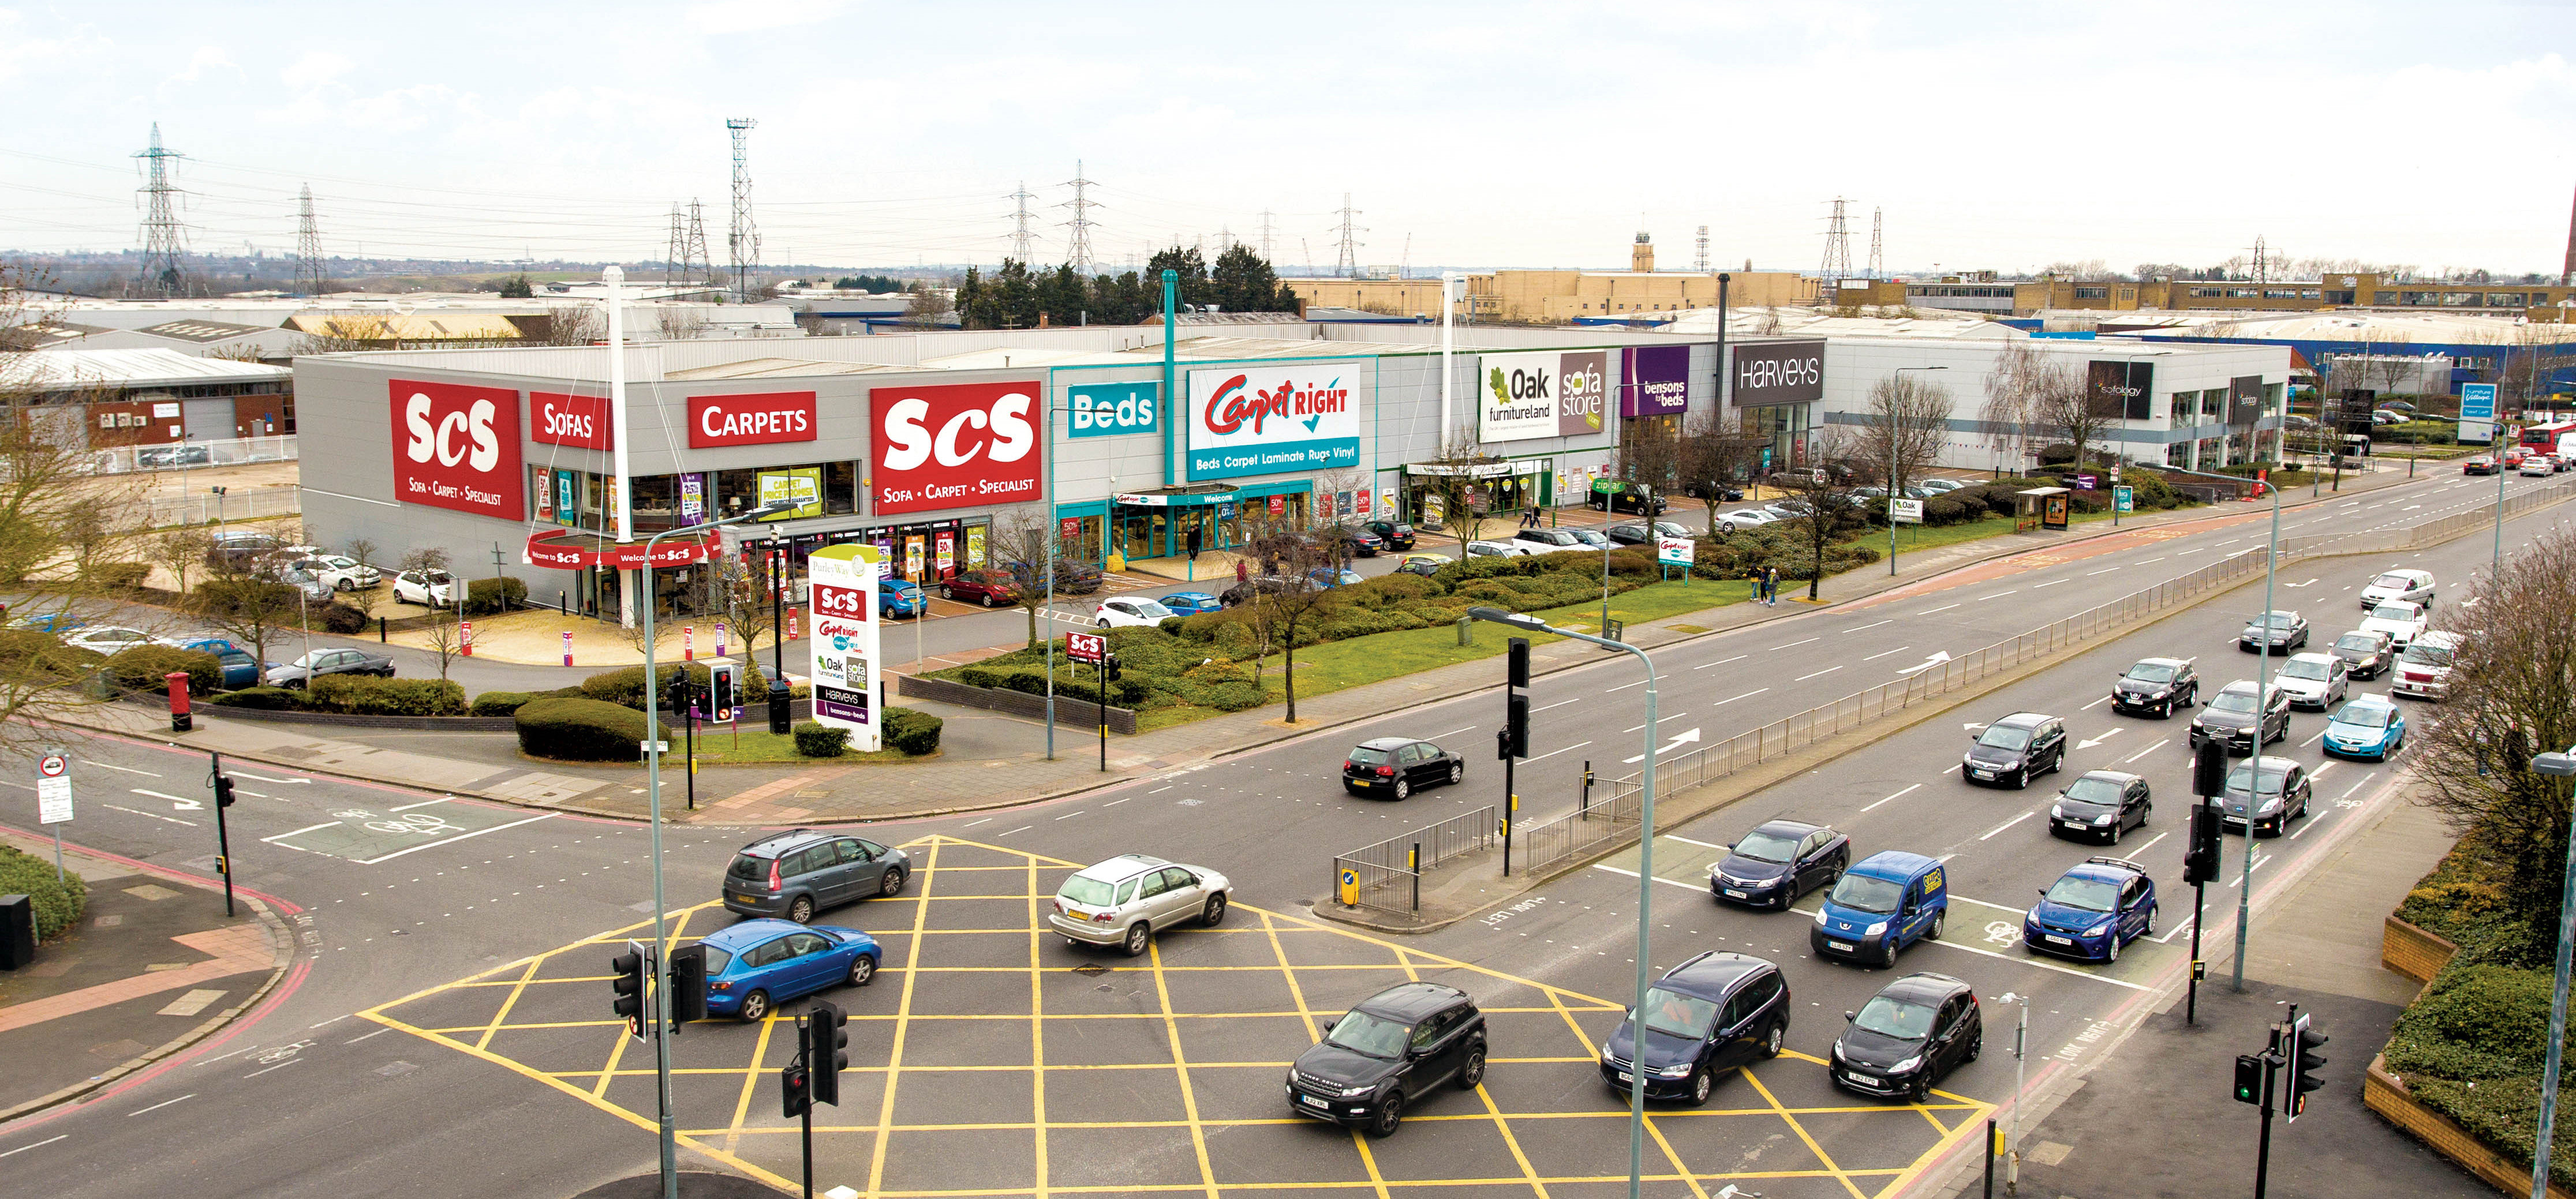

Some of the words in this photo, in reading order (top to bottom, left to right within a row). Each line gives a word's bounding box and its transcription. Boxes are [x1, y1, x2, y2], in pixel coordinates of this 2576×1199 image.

[1512, 368, 1550, 400] Oak
[1562, 362, 1602, 395] sofa
[1645, 380, 1685, 395] bensons
[1205, 374, 1295, 435] Carpet
[1562, 393, 1601, 416] store
[1661, 392, 1684, 407] beds
[1074, 392, 1153, 429] Beds
[1490, 403, 1550, 421] furnitureland
[544, 403, 592, 438] SOFAS
[702, 406, 807, 437] CARPETS
[406, 393, 499, 472] ScS
[883, 393, 1034, 471] ScS
[1196, 458, 1220, 471] Beds
[1224, 454, 1258, 468] Carpet
[1262, 452, 1304, 464] Laminate
[1308, 449, 1330, 462] Rugs
[1333, 447, 1354, 459] Vinyl
[409, 477, 426, 493] SOFA
[433, 481, 458, 498] CARPET
[465, 485, 501, 505] SPECIALIST
[764, 490, 782, 500] PRICE
[884, 488, 913, 503] SOFA
[925, 484, 967, 499] CARPET
[979, 479, 1034, 494] SPECIALIST
[1204, 494, 1233, 503] Welcome
[532, 550, 549, 560] Welcome
[557, 552, 580, 564] ScS
[667, 548, 690, 561] ScS
[821, 588, 858, 612] ScS
[819, 620, 843, 638] Carpet
[1071, 635, 1099, 653] ScS
[827, 658, 843, 672] Oak
[848, 663, 866, 676] sofa
[848, 673, 866, 684] store
[830, 706, 851, 716] bensons
[853, 711, 865, 720] beds
[1508, 898, 1543, 913] LOOK
[1479, 911, 1515, 926] LEFT
[2054, 1043, 2087, 1061] LOOK
[2076, 1024, 2110, 1043] RIGHT
